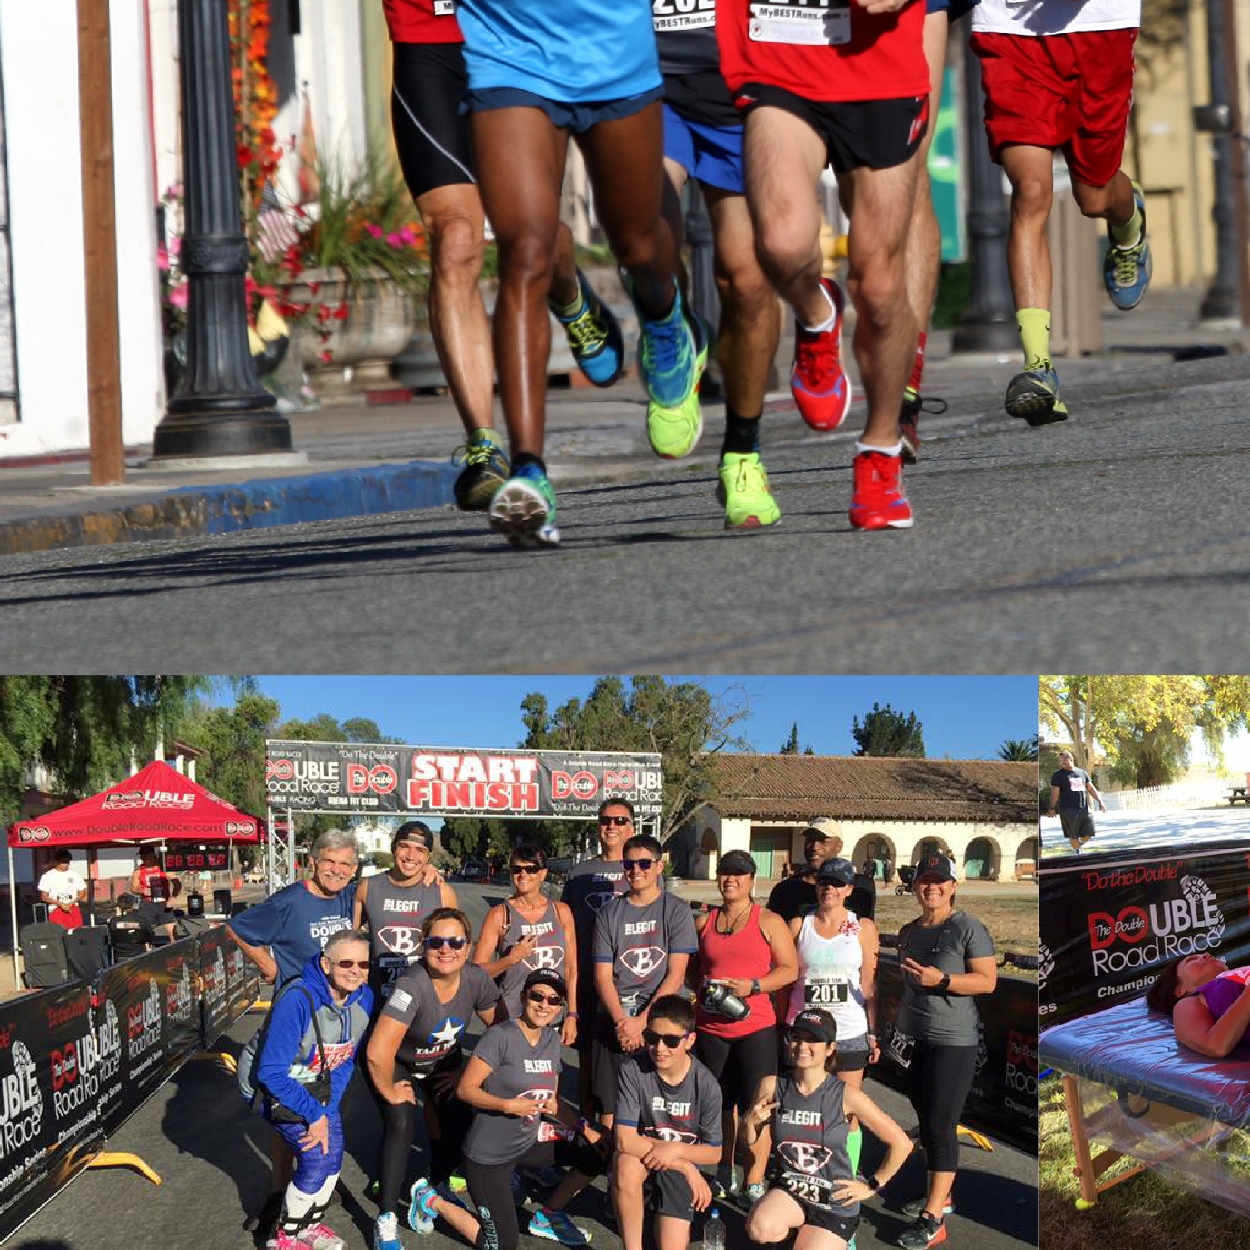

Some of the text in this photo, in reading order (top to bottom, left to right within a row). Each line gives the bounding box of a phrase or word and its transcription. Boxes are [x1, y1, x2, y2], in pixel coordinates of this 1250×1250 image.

[655, 16, 716, 29] yBESTRuns.c
[760, 7, 842, 20] MyBESTRuns.com
[411, 751, 538, 784] START
[266, 779, 340, 794] oad Race
[603, 770, 662, 790] DOUBL
[106, 789, 196, 804] DOUBLE
[407, 779, 540, 811] FINISH
[640, 788, 662, 802] Ra
[1094, 917, 1145, 937] The Double
[1092, 930, 1222, 976] Road Race
[811, 984, 841, 1003] 201
[1097, 973, 1160, 998] Champio
